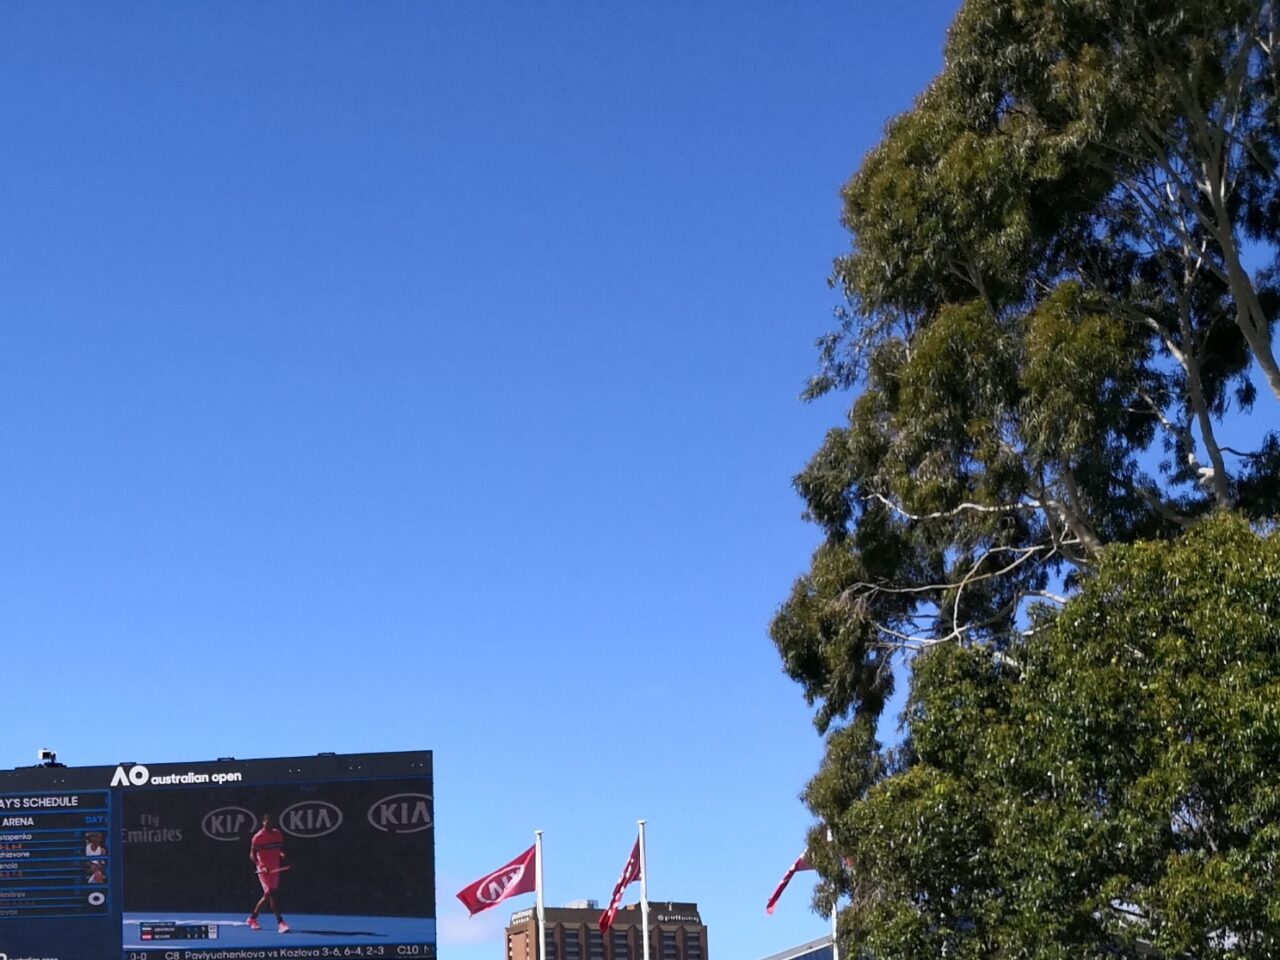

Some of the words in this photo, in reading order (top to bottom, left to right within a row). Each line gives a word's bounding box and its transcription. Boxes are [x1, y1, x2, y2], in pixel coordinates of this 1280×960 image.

[151, 772, 209, 785] australian
[212, 772, 242, 784] open
[23, 796, 78, 807] SCHEDULE
[290, 809, 332, 830] KIA
[380, 801, 430, 825] KIA
[2, 817, 34, 827] ARENA
[185, 951, 265, 960] Pavlyuchenkova
[267, 950, 278, 958] vs
[280, 947, 320, 957] Kozlova
[366, 946, 384, 955] 2-3
[397, 945, 419, 954] C10
